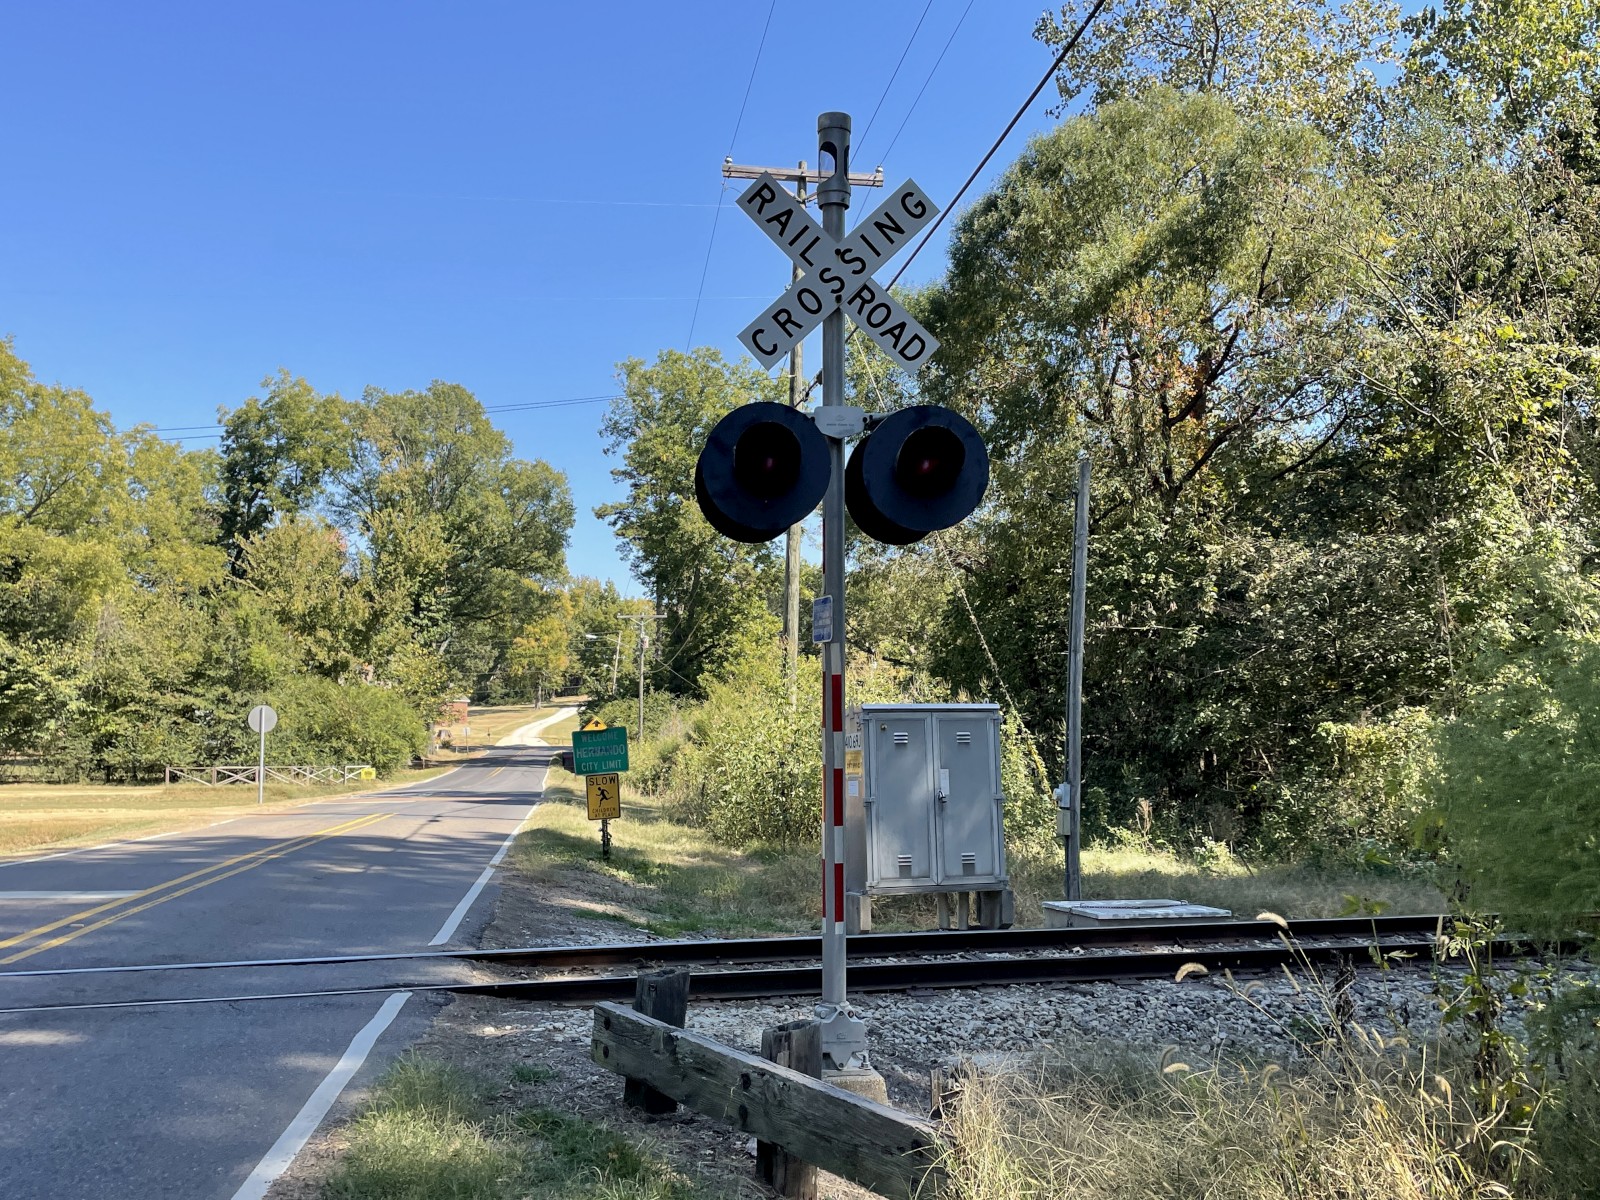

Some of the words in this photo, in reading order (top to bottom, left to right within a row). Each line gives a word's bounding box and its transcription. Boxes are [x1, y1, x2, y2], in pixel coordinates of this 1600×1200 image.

[751, 191, 927, 356] CROSSING
[581, 731, 618, 742] WELCOME
[576, 744, 625, 759] HERNANDO
[581, 761, 599, 772] CITY
[602, 759, 622, 770] LIMIT
[589, 776, 616, 786] SLOW
